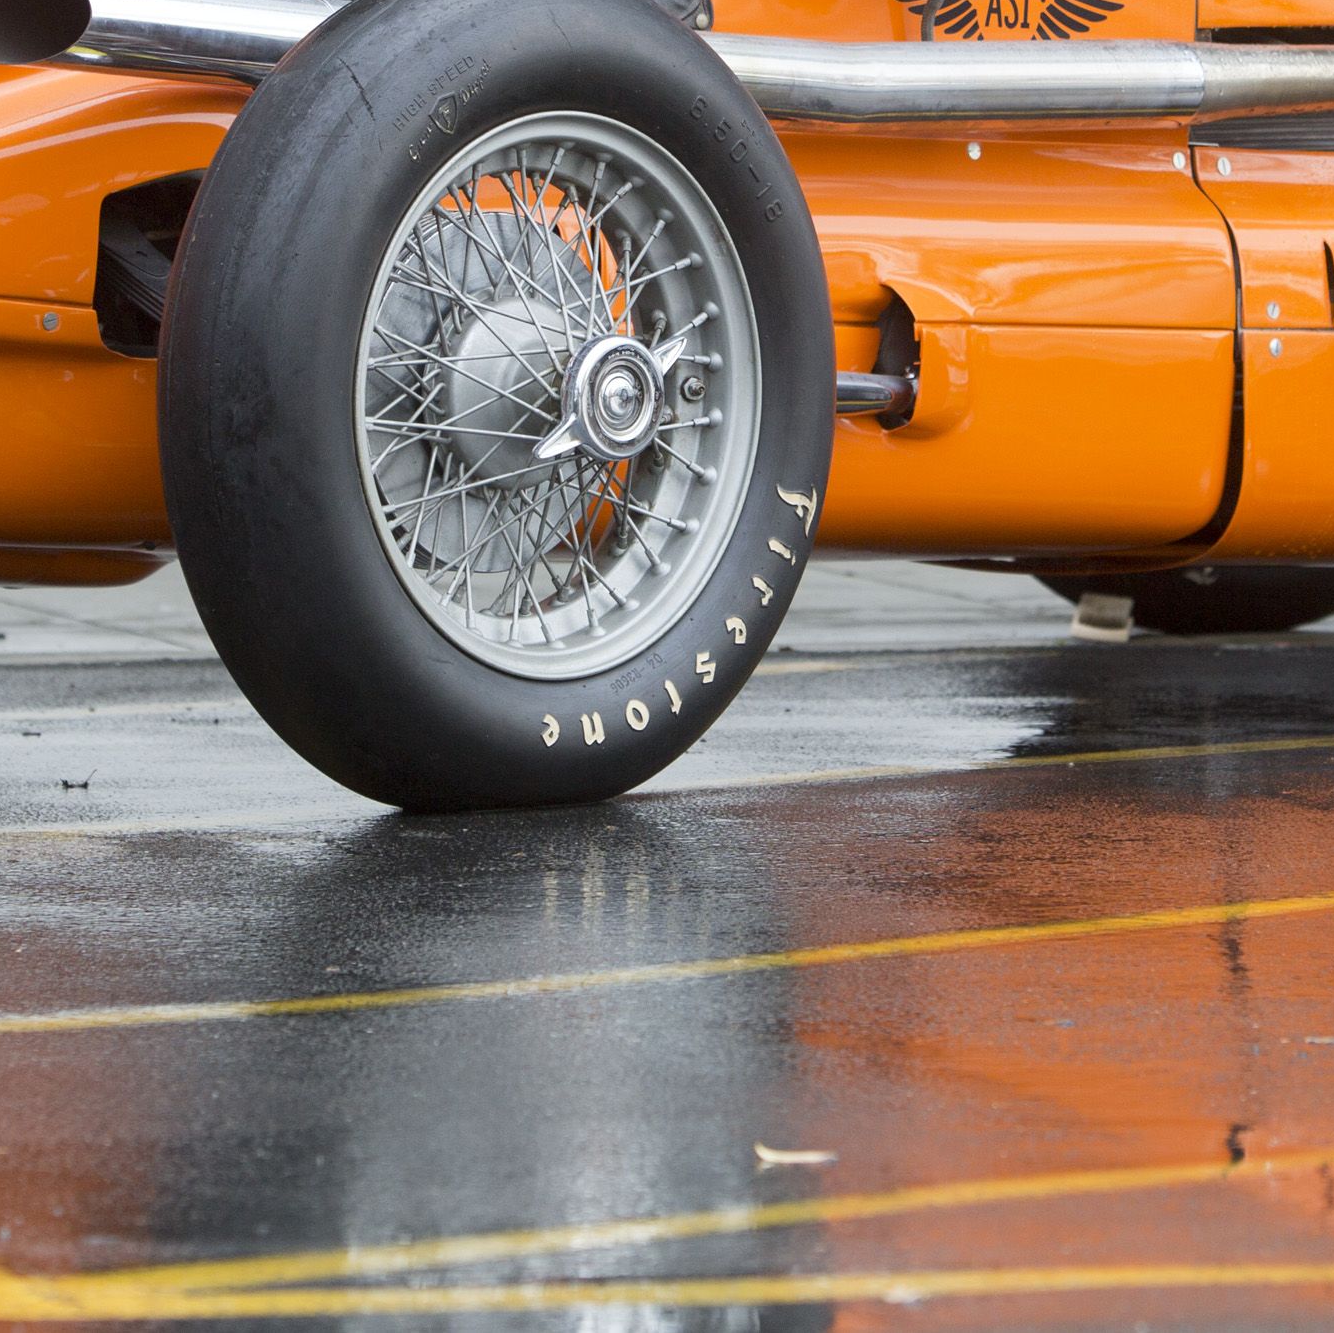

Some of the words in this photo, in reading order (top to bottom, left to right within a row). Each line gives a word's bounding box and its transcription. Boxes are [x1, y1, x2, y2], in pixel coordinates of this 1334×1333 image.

[392, 93, 427, 132] HIGH
[427, 55, 475, 96] SPEED
[540, 482, 818, 748] Firestone
